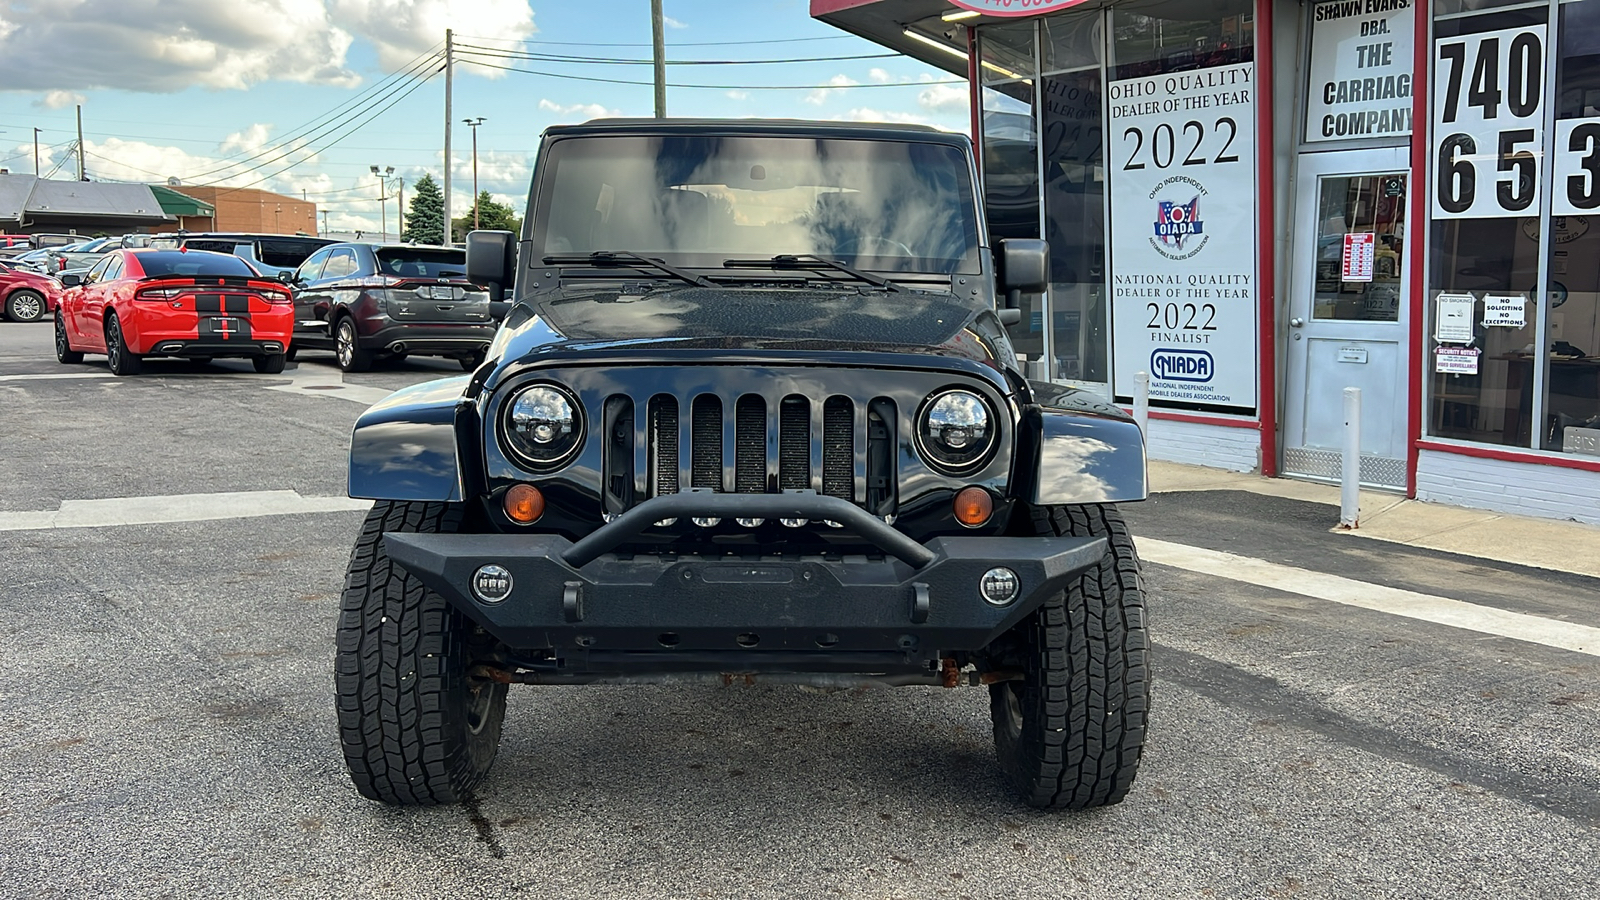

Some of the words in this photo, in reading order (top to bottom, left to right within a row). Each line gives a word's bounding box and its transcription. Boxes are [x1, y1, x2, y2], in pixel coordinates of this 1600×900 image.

[1316, 1, 1362, 21] SHAWN
[1360, 19, 1390, 37] DBA.
[1356, 42, 1392, 68] THE
[1110, 81, 1156, 100] OHIO
[1165, 67, 1252, 95] QUALITY
[1440, 32, 1542, 123] 740
[1323, 74, 1413, 105] CARRIAG
[1112, 101, 1160, 118] DEALER
[1163, 99, 1180, 113] OF
[1183, 95, 1210, 110] THE
[1213, 90, 1250, 106] YEAR
[1322, 108, 1413, 137] COMPANY
[1123, 117, 1239, 171] 2022
[1149, 183, 1163, 199] OHIO
[1164, 176, 1208, 196] INDEPENDENT
[1160, 223, 1194, 235] OIADA
[1149, 237, 1169, 258] AUTOMOBILE
[1188, 235, 1209, 259] ASSOCIATION
[1115, 275, 1182, 284] NATIONAL
[1188, 275, 1251, 286] QUALITY
[1116, 288, 1161, 297] DEALER
[1166, 288, 1181, 297] OF
[1186, 289, 1210, 298] THE
[1216, 289, 1249, 298] YEAR
[1147, 302, 1217, 330] 2022
[1151, 332, 1210, 344] FINALIST
[1155, 355, 1208, 375] NIADA
[1171, 391, 1193, 399] DEALERS
[1194, 394, 1231, 402] ASSOCIATION
